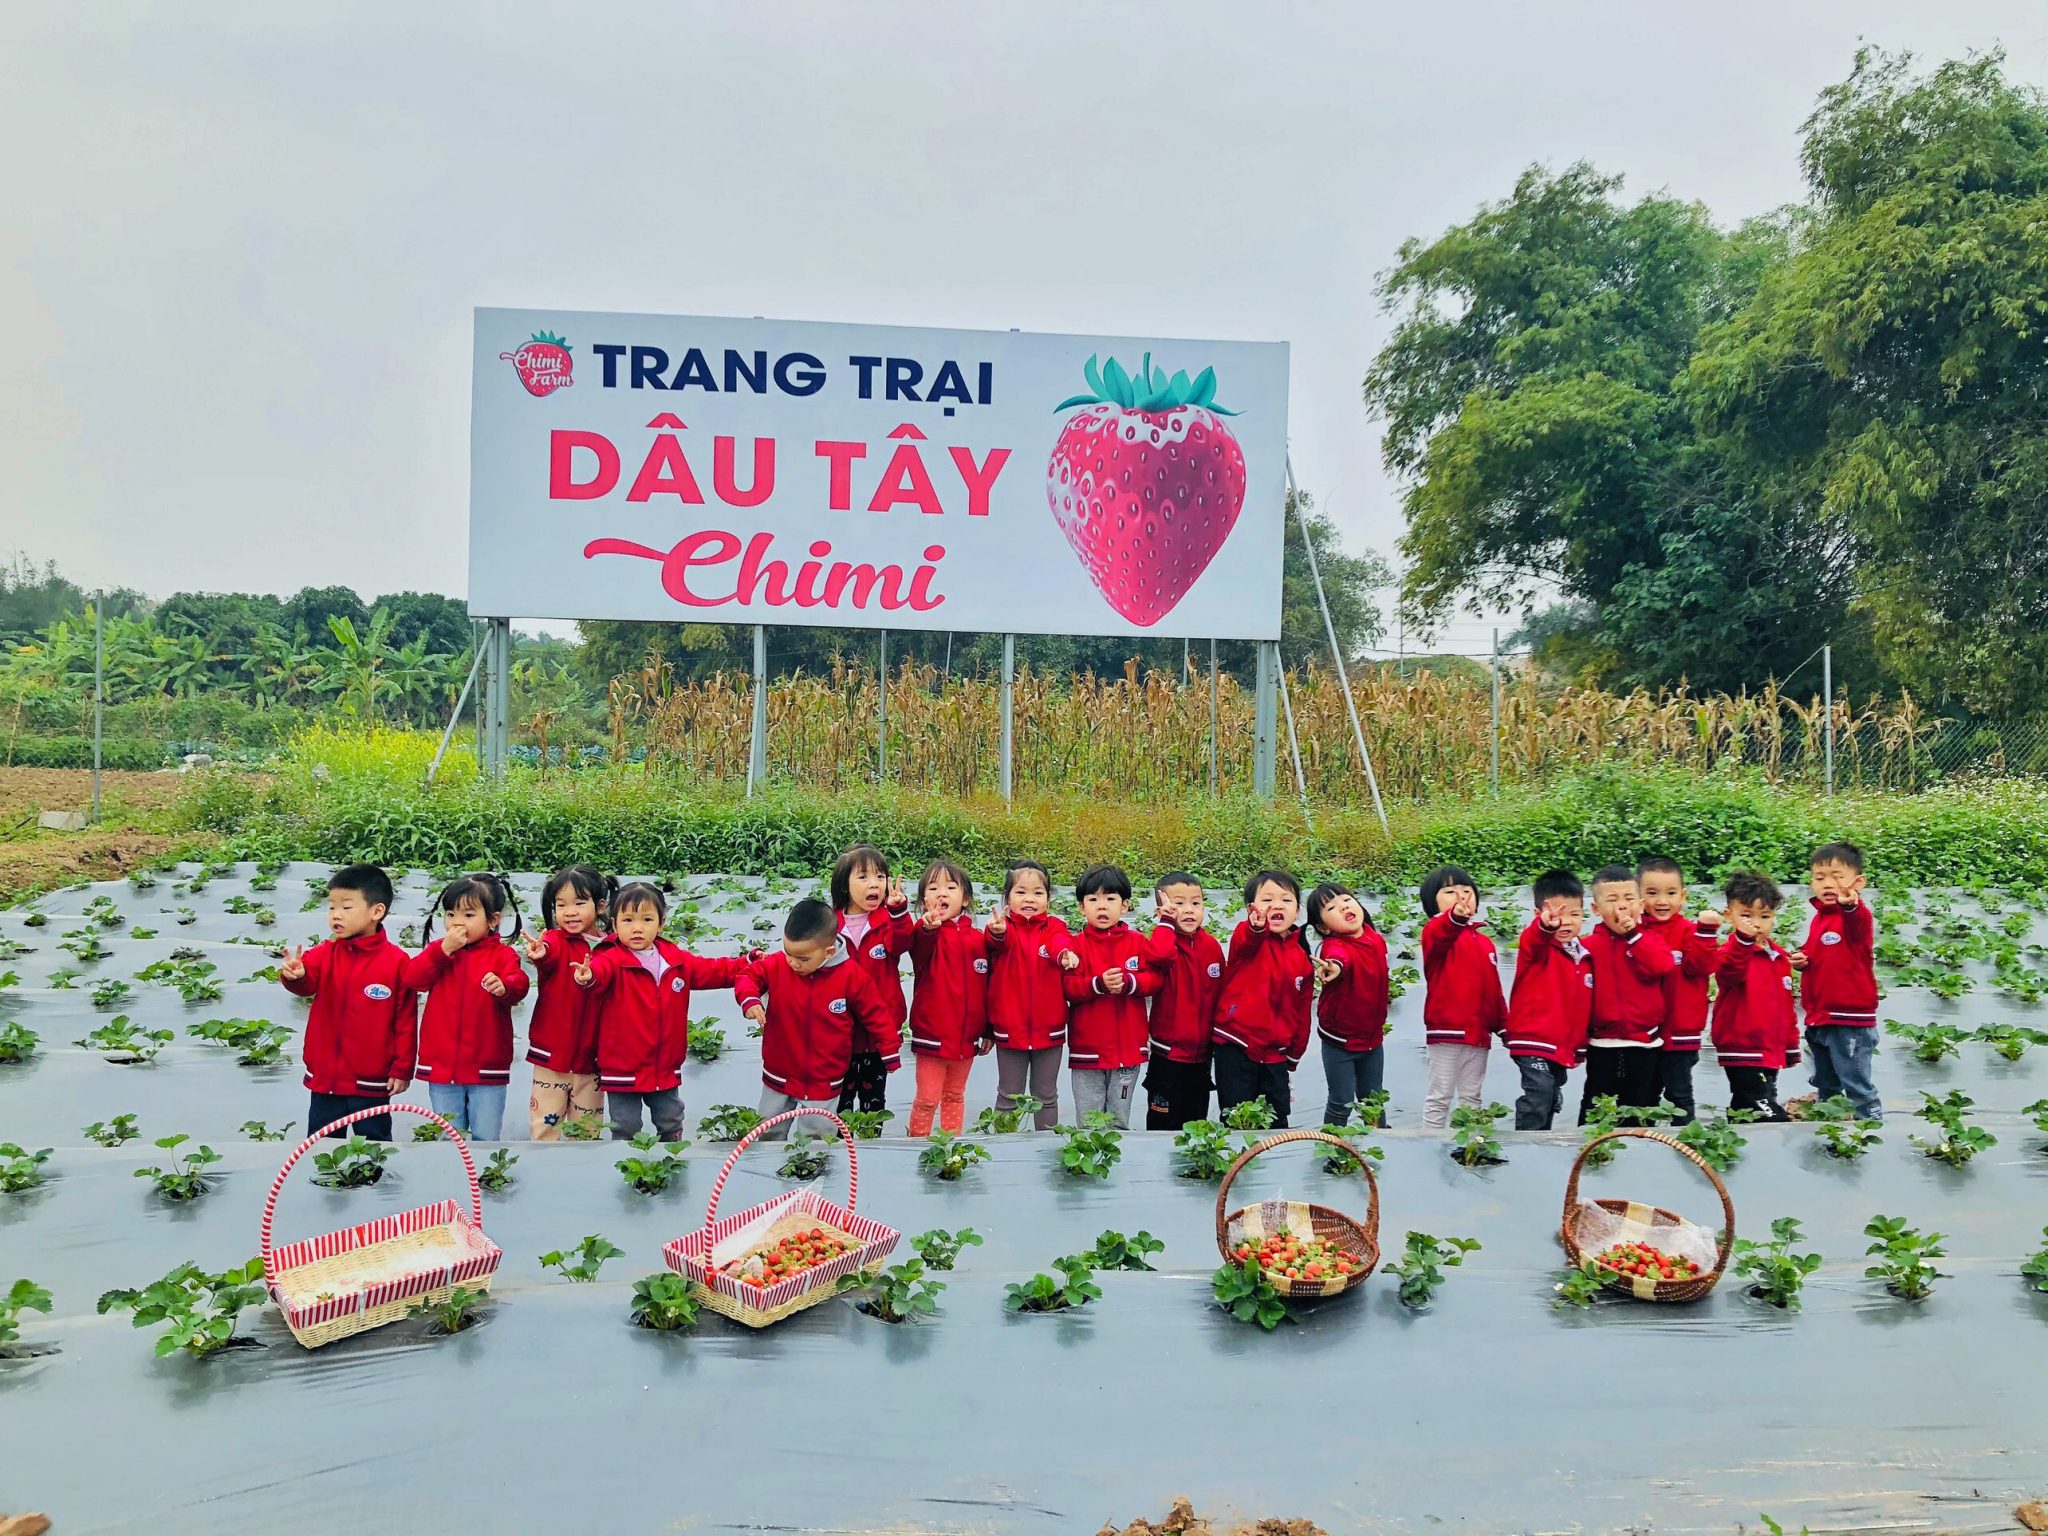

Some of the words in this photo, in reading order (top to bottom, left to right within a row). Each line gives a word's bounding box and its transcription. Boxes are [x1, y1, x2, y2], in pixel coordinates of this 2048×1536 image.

[500, 351, 563, 369] Chimi
[530, 368, 574, 387] Farm
[593, 344, 827, 397] TRANG
[850, 356, 993, 417] TRẠI
[549, 412, 776, 508] DÂU
[815, 423, 1012, 517] TÂY
[583, 530, 946, 612] Chimi
